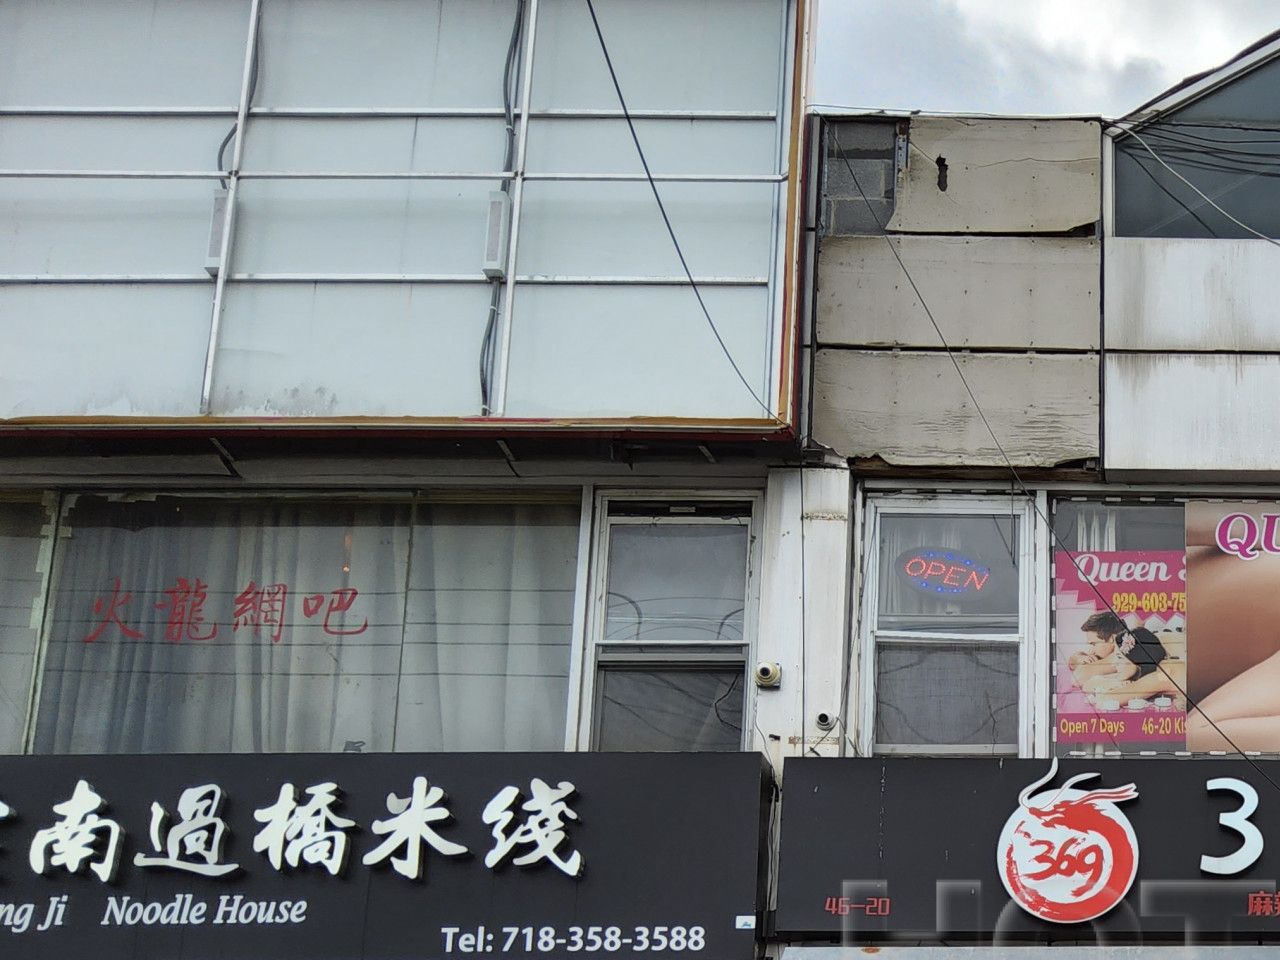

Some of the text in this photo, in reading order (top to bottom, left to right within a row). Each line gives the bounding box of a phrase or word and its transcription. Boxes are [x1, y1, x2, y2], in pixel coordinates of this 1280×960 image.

[904, 556, 990, 591] OPEN
[1075, 554, 1171, 583] Queen
[1060, 718, 1089, 737] Open
[1090, 718, 1097, 733] 7
[1099, 718, 1125, 737] Days
[1141, 717, 1172, 735] 46-20
[37, 895, 69, 932] Ji
[102, 895, 207, 926] Noodle
[213, 893, 308, 926] House
[824, 896, 891, 917] 46-20
[441, 925, 706, 955] Tel: 718-358-3588
